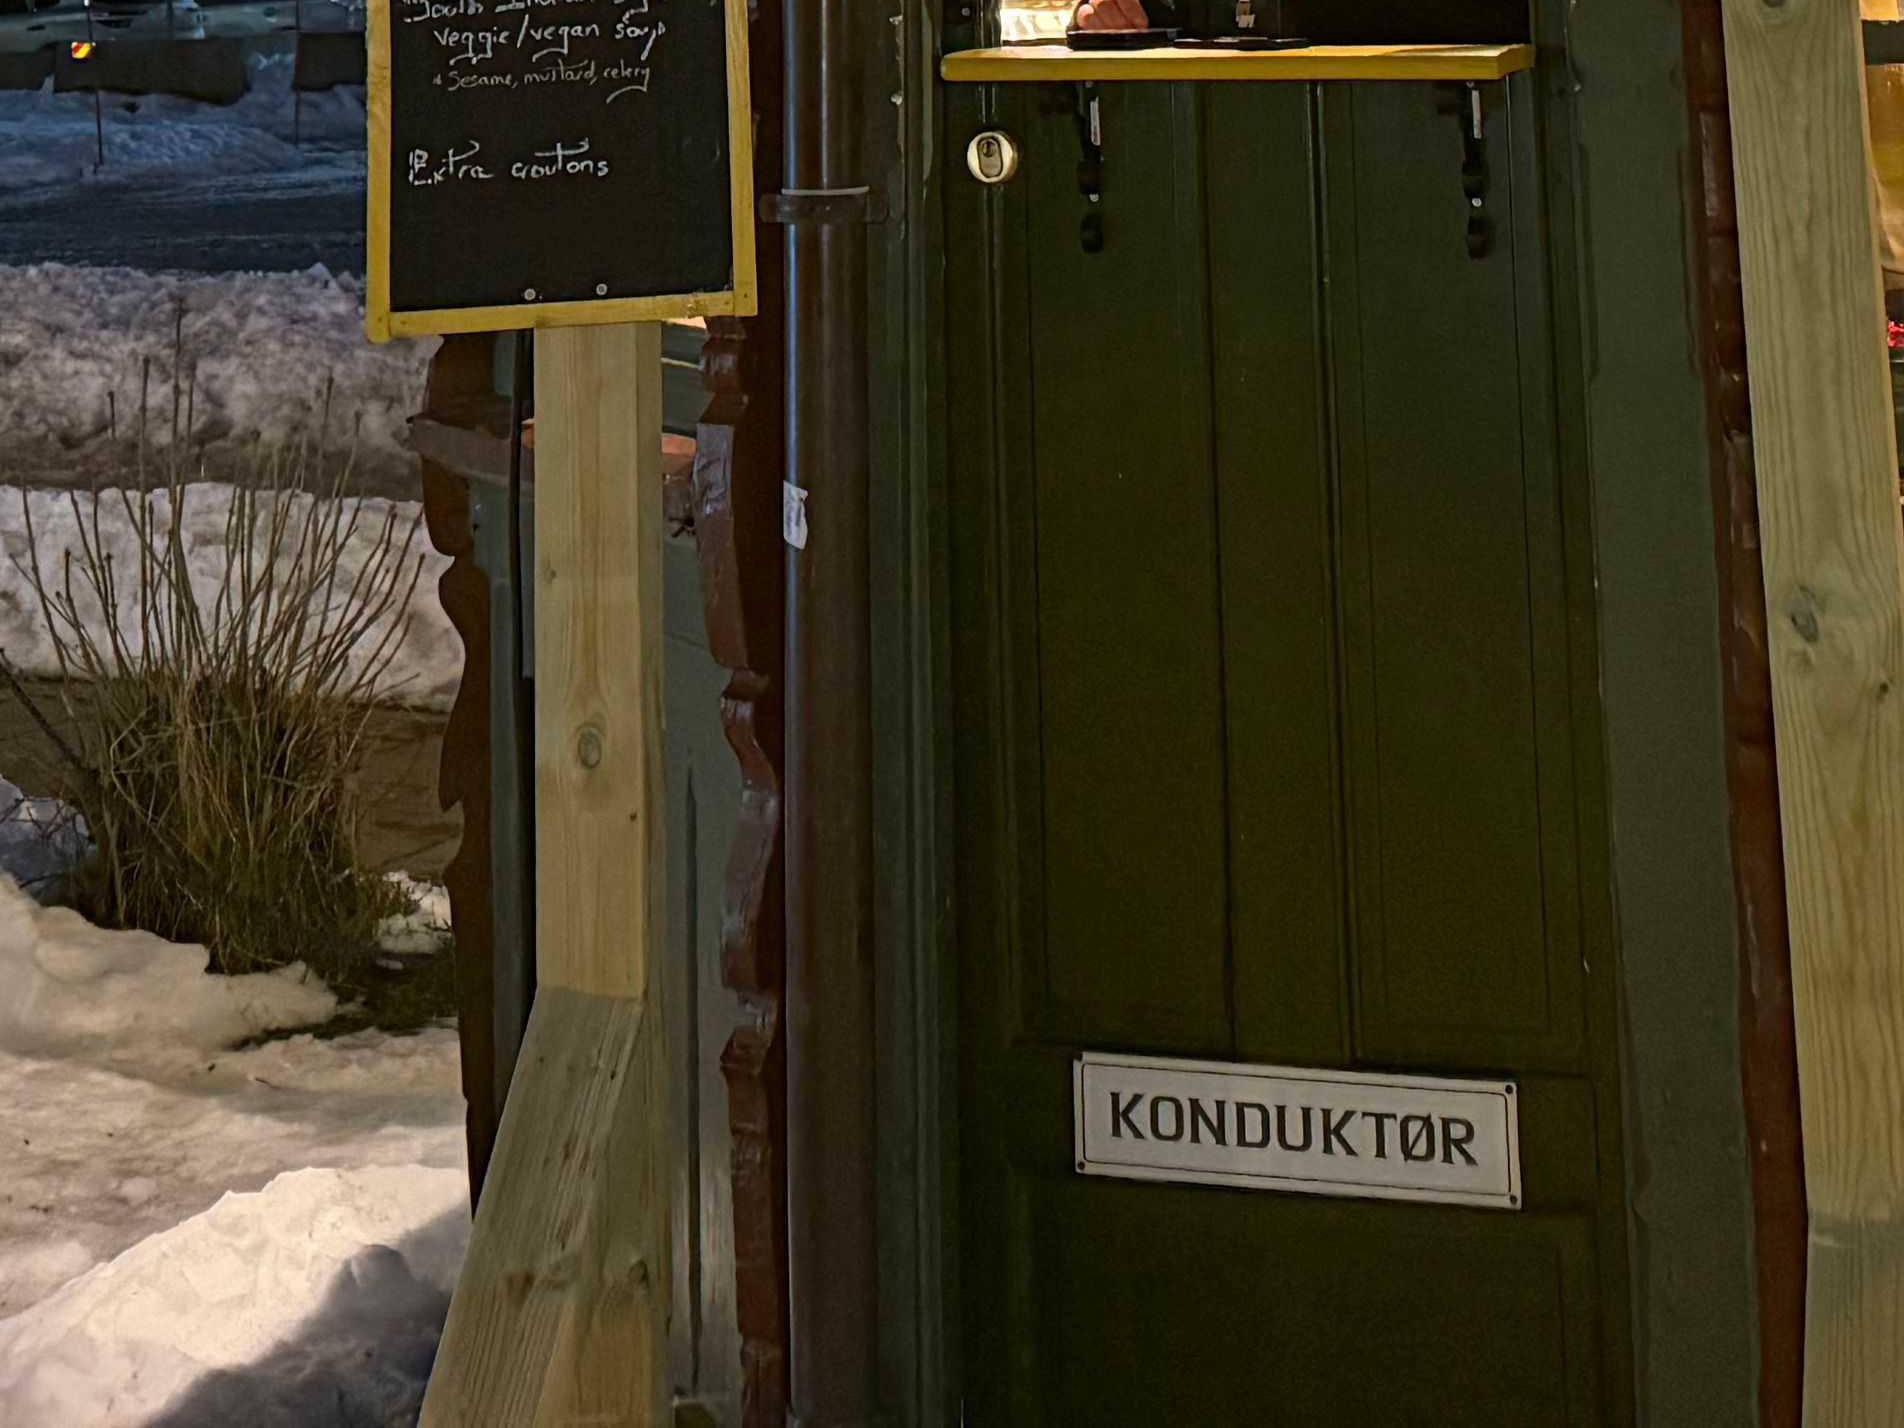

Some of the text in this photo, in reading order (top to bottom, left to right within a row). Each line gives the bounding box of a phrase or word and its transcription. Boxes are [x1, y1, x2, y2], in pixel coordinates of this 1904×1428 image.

[408, 137, 609, 186] Extra croutons
[1109, 1092, 1478, 1166] KONDUKTØR
